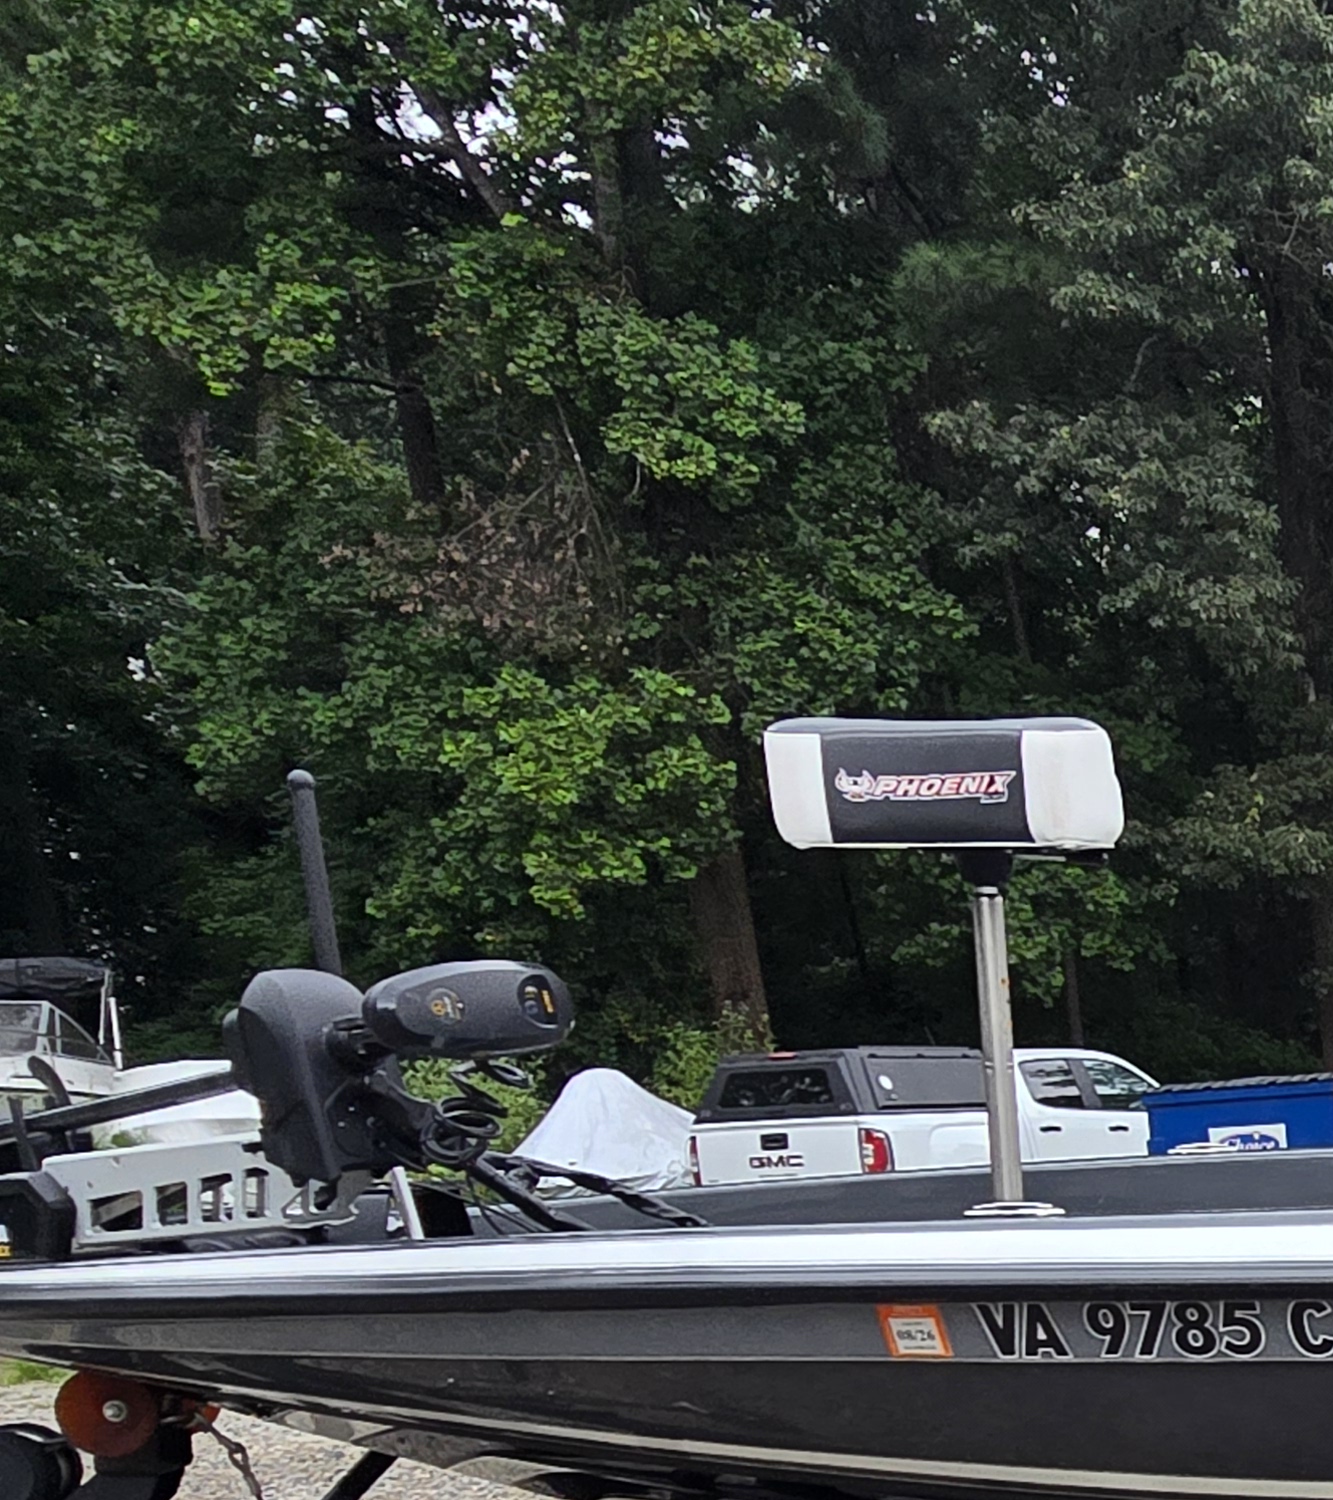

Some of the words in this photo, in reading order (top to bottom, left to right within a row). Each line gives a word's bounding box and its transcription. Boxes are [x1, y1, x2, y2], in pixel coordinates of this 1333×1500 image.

[872, 773, 1012, 797] PHOENIX
[749, 1155, 804, 1169] GMC
[973, 1301, 1073, 1359] VA
[1084, 1301, 1266, 1359] 9785
